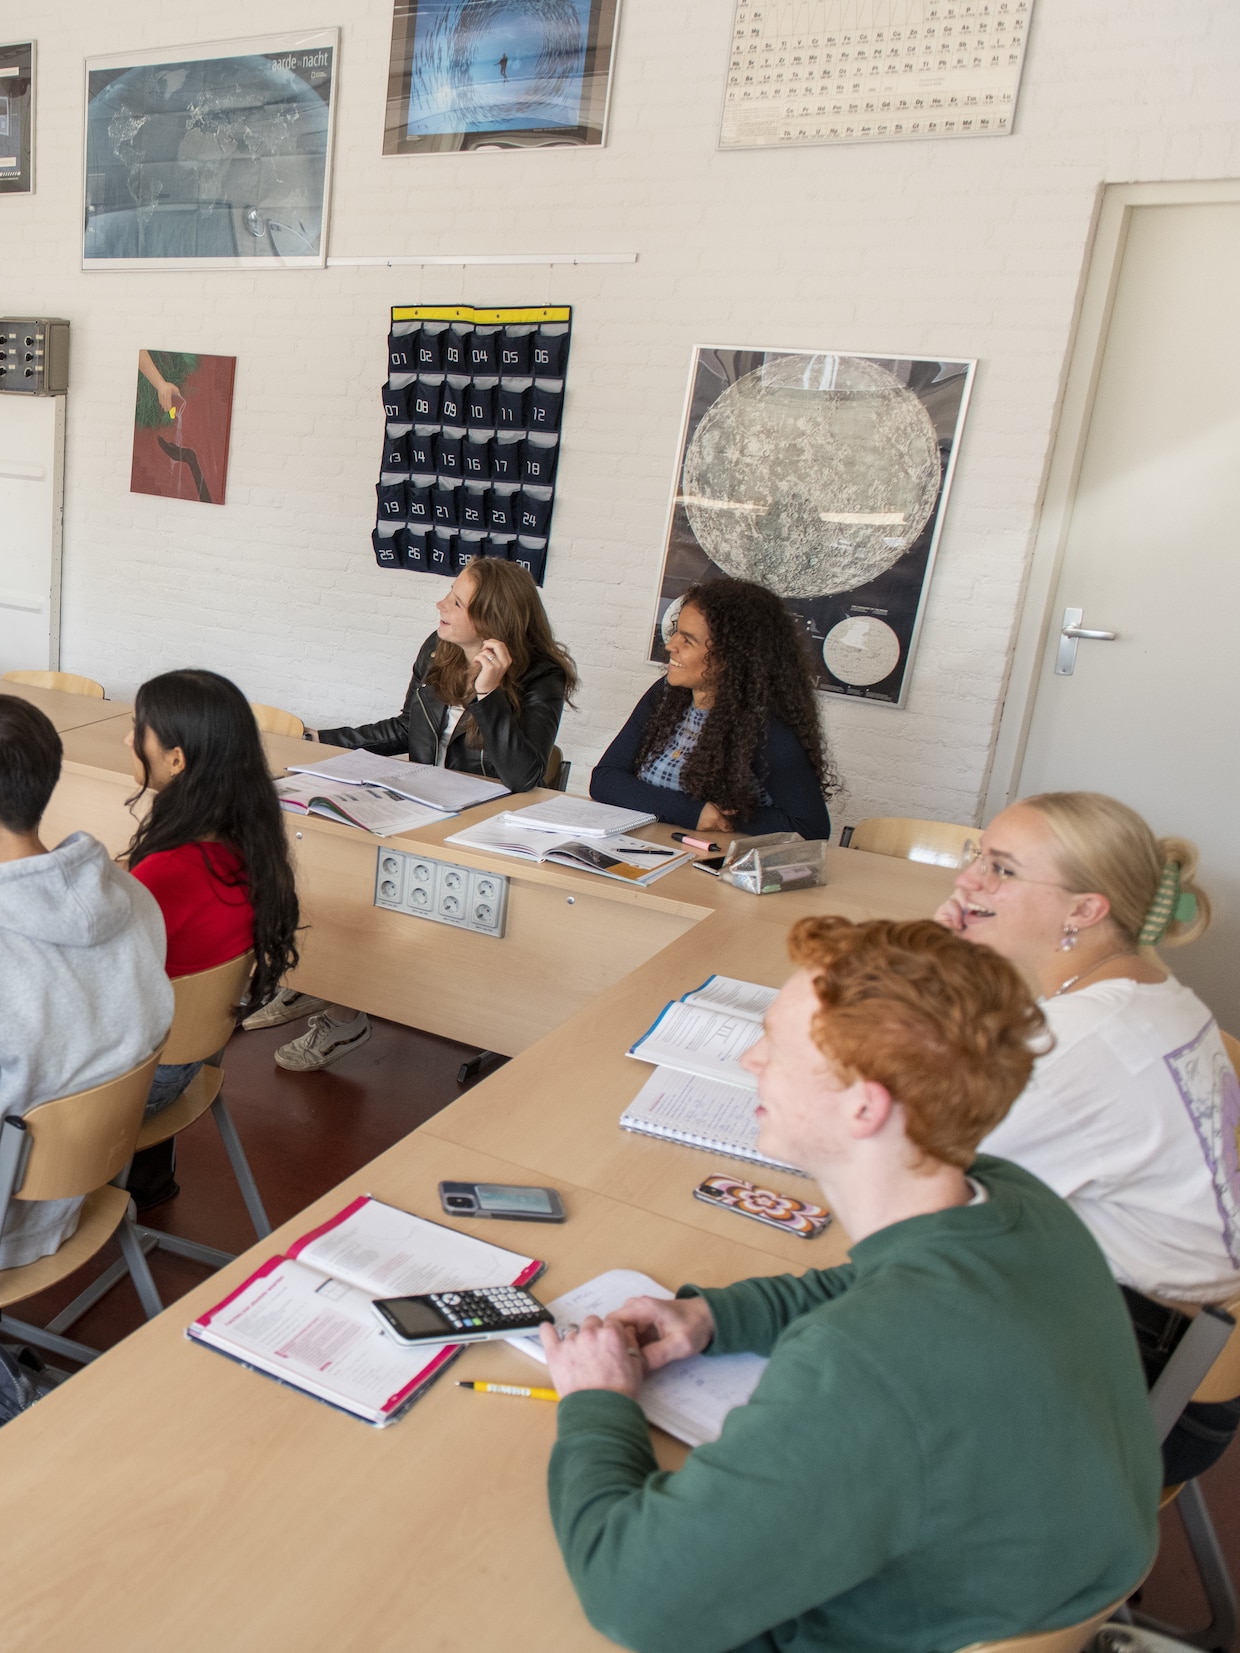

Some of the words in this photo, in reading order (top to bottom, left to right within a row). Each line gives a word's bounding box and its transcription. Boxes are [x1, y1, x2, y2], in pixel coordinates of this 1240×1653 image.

[271, 54, 297, 71] aarde
[302, 50, 329, 68] nacht
[392, 354, 407, 364] 01
[420, 349, 432, 362] 02
[448, 347, 458, 362] 03
[472, 350, 488, 362] 04
[503, 351, 518, 363] 05
[535, 349, 548, 363] 06
[385, 405, 399, 417] 07
[416, 399, 428, 413] 08
[444, 401, 456, 417] 09
[471, 405, 483, 418] 10
[502, 408, 512, 421] 11
[534, 407, 545, 421] 12
[390, 453, 401, 462] 13
[413, 450, 425, 462] 14
[442, 453, 455, 466] 15
[467, 458, 480, 470] 16
[495, 460, 507, 471] 17
[527, 461, 539, 475] 18
[384, 502, 399, 513] 19
[412, 503, 425, 514] 20
[436, 506, 448, 518] 21
[466, 508, 479, 520] 22
[493, 510, 506, 523] 23
[523, 512, 536, 527] 24
[379, 550, 394, 560] 25
[408, 546, 420, 559] 26
[433, 549, 444, 562] 27
